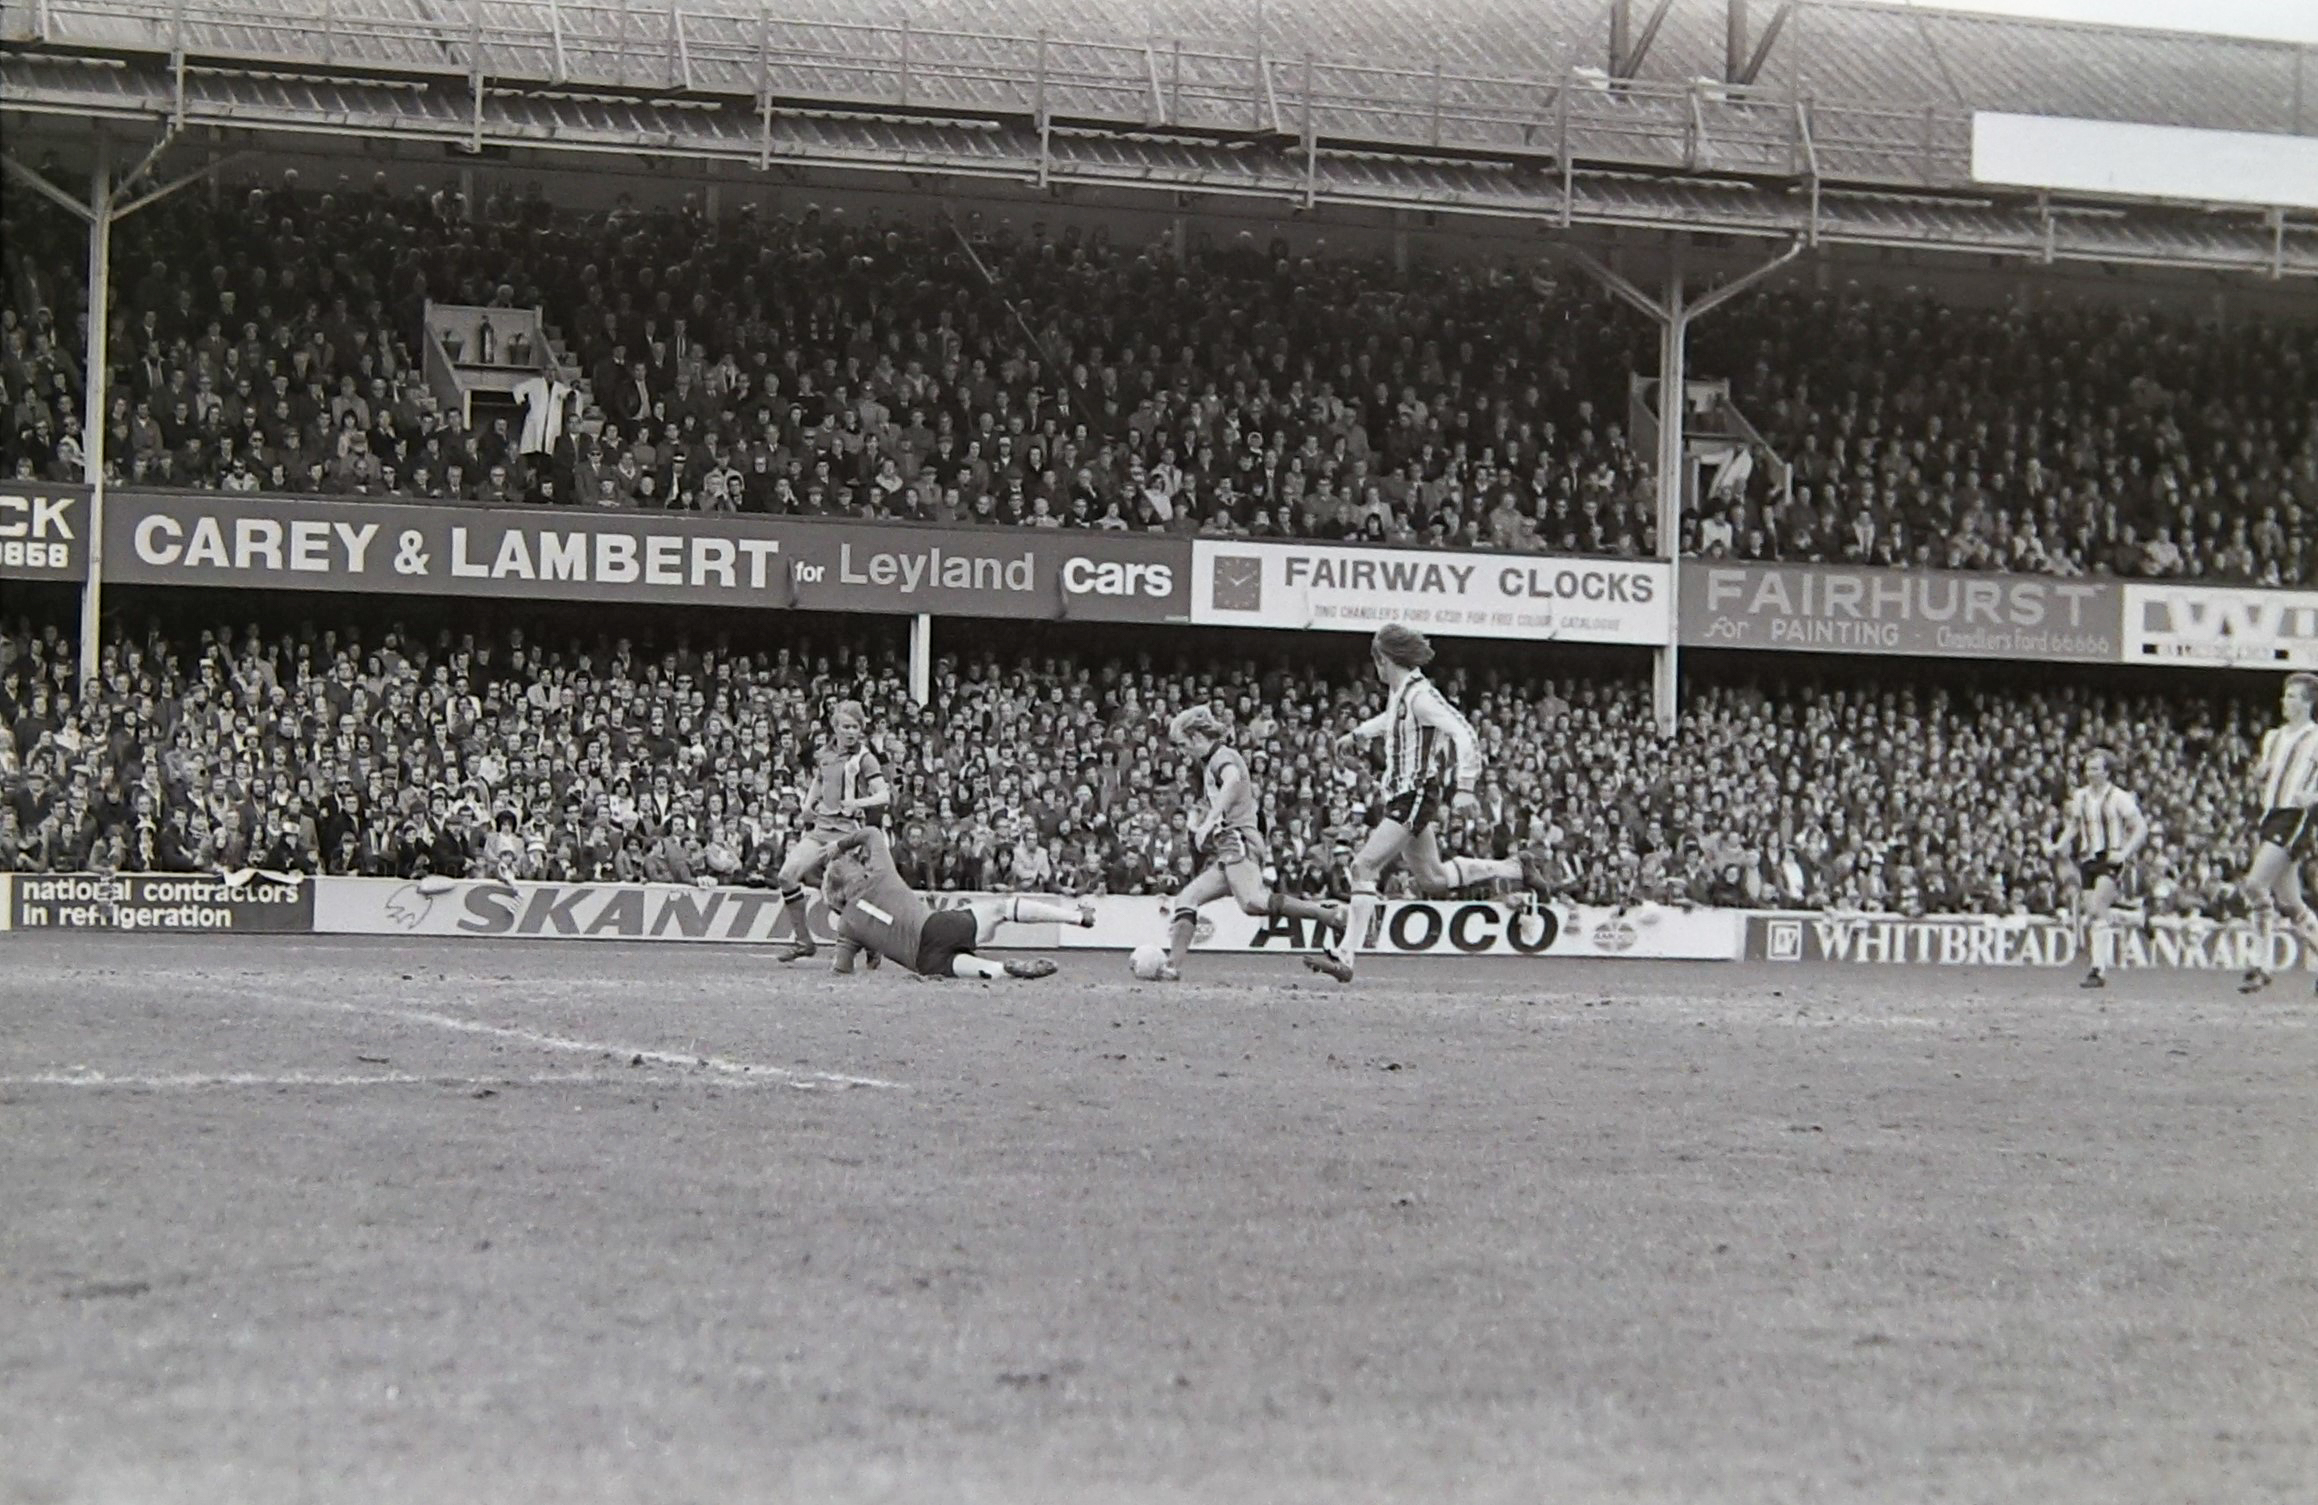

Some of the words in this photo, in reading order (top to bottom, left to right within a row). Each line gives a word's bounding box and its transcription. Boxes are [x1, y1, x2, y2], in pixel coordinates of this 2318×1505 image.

[0, 541, 68, 568] 858
[134, 514, 380, 573] CAREY
[394, 529, 430, 576] &
[451, 527, 779, 588] LAMBERT
[796, 561, 825, 583] for
[840, 543, 1034, 592] Leyland
[1063, 557, 1172, 597] Cars
[1285, 556, 1475, 594] FAIRWAY
[1499, 568, 1653, 602] CLOCKS
[1708, 569, 2096, 627] FAIRHURST
[1771, 618, 1899, 646] PAINTING
[143, 881, 299, 903] contractors
[23, 903, 48, 926] in
[1811, 921, 2077, 967] WHITBREAD
